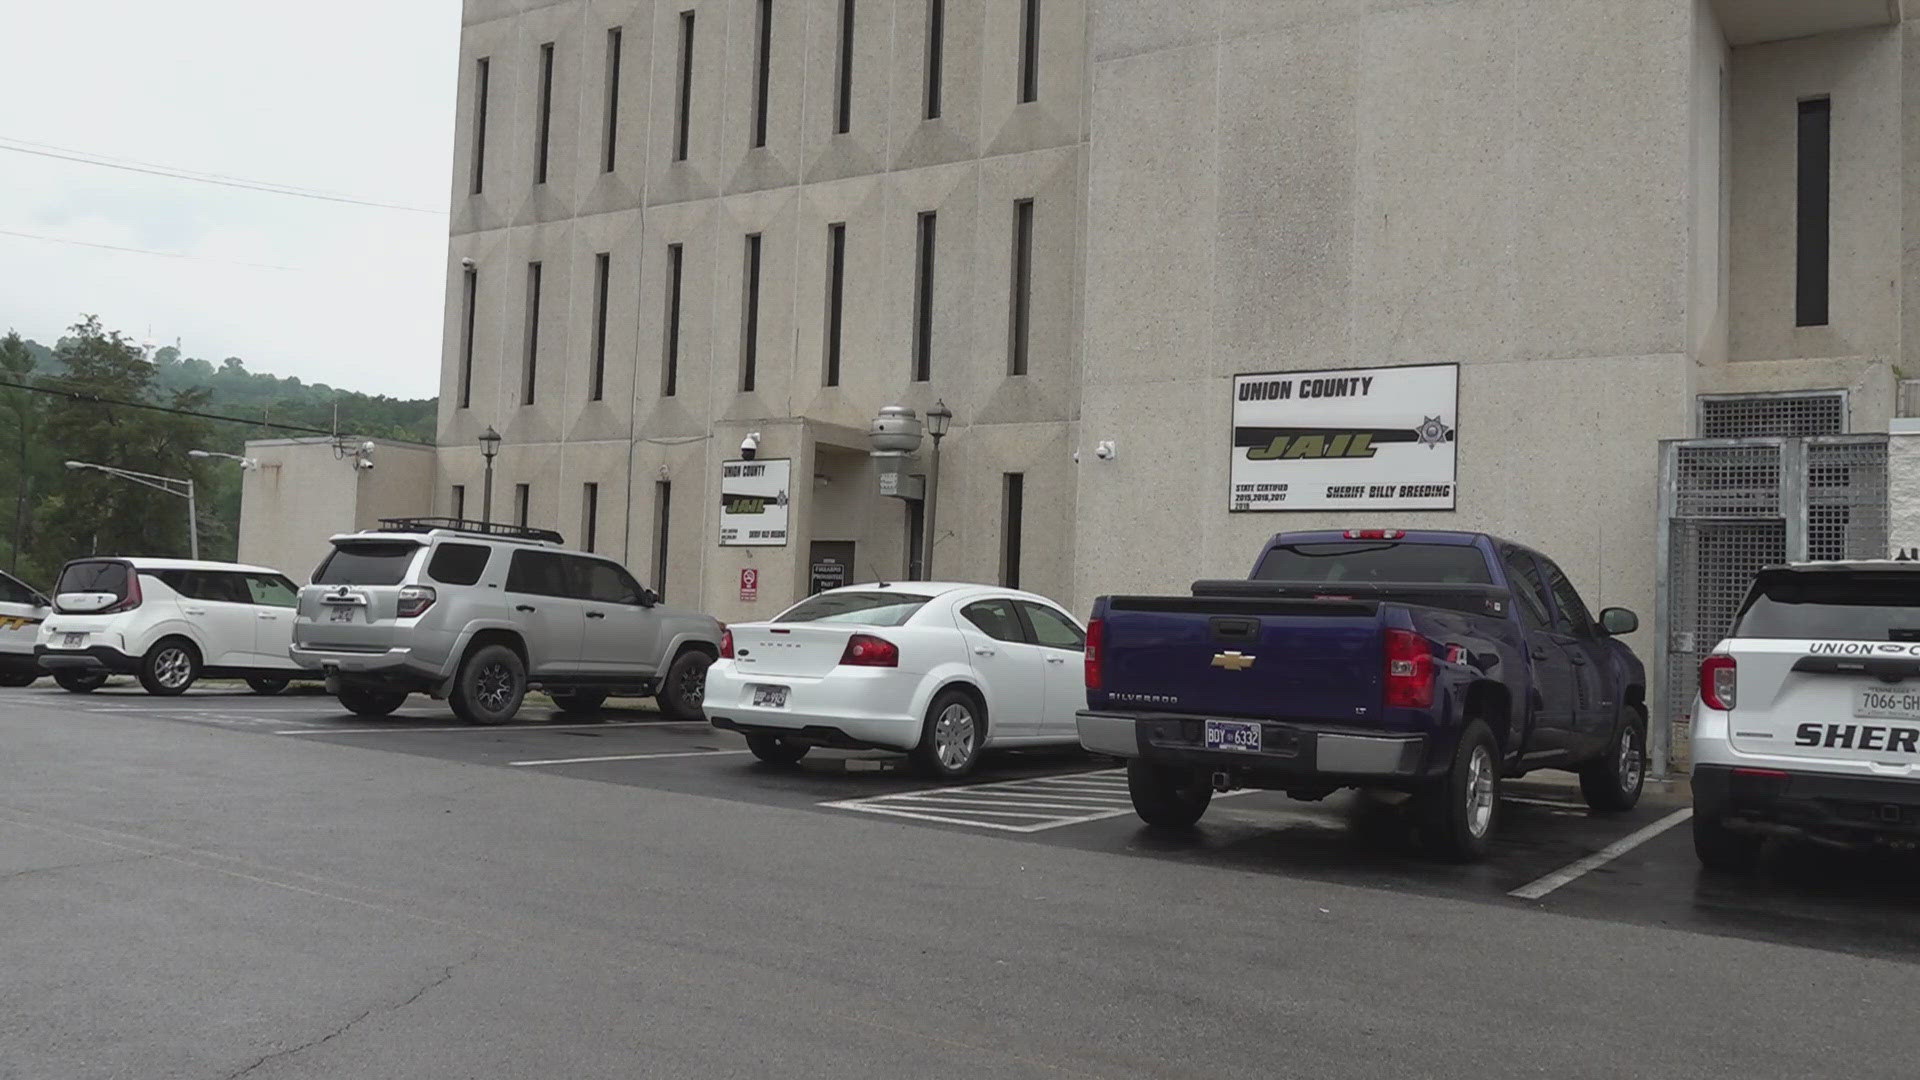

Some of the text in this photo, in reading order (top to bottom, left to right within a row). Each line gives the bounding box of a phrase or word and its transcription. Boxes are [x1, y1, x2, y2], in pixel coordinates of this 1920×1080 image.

[1238, 376, 1374, 401] UNION COUNTY
[1246, 433, 1378, 460] JAIL
[743, 465, 766, 477] COUNTY
[1326, 485, 1451, 498] SHERIFF BILLY BREEDING
[726, 499, 765, 514] JAIL
[1809, 642, 1874, 655] UNION
[1234, 730, 1259, 746] 6332
[1794, 723, 1920, 753] SHER
